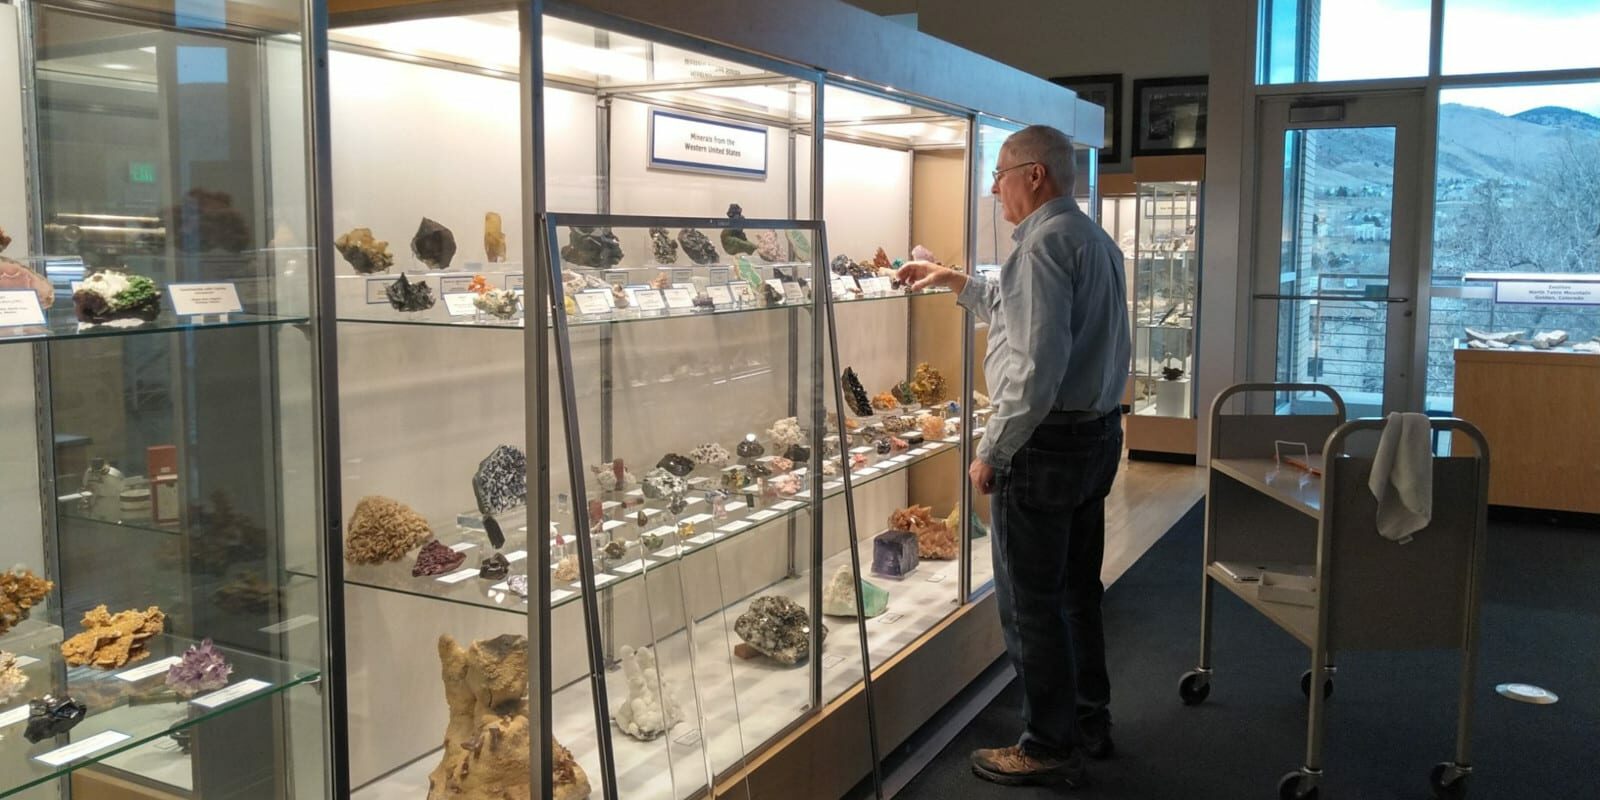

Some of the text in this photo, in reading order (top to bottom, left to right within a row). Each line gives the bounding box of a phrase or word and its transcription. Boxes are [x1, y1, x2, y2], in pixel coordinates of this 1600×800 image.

[691, 132, 736, 146] Minerals from the
[685, 142, 741, 157] Western United States
